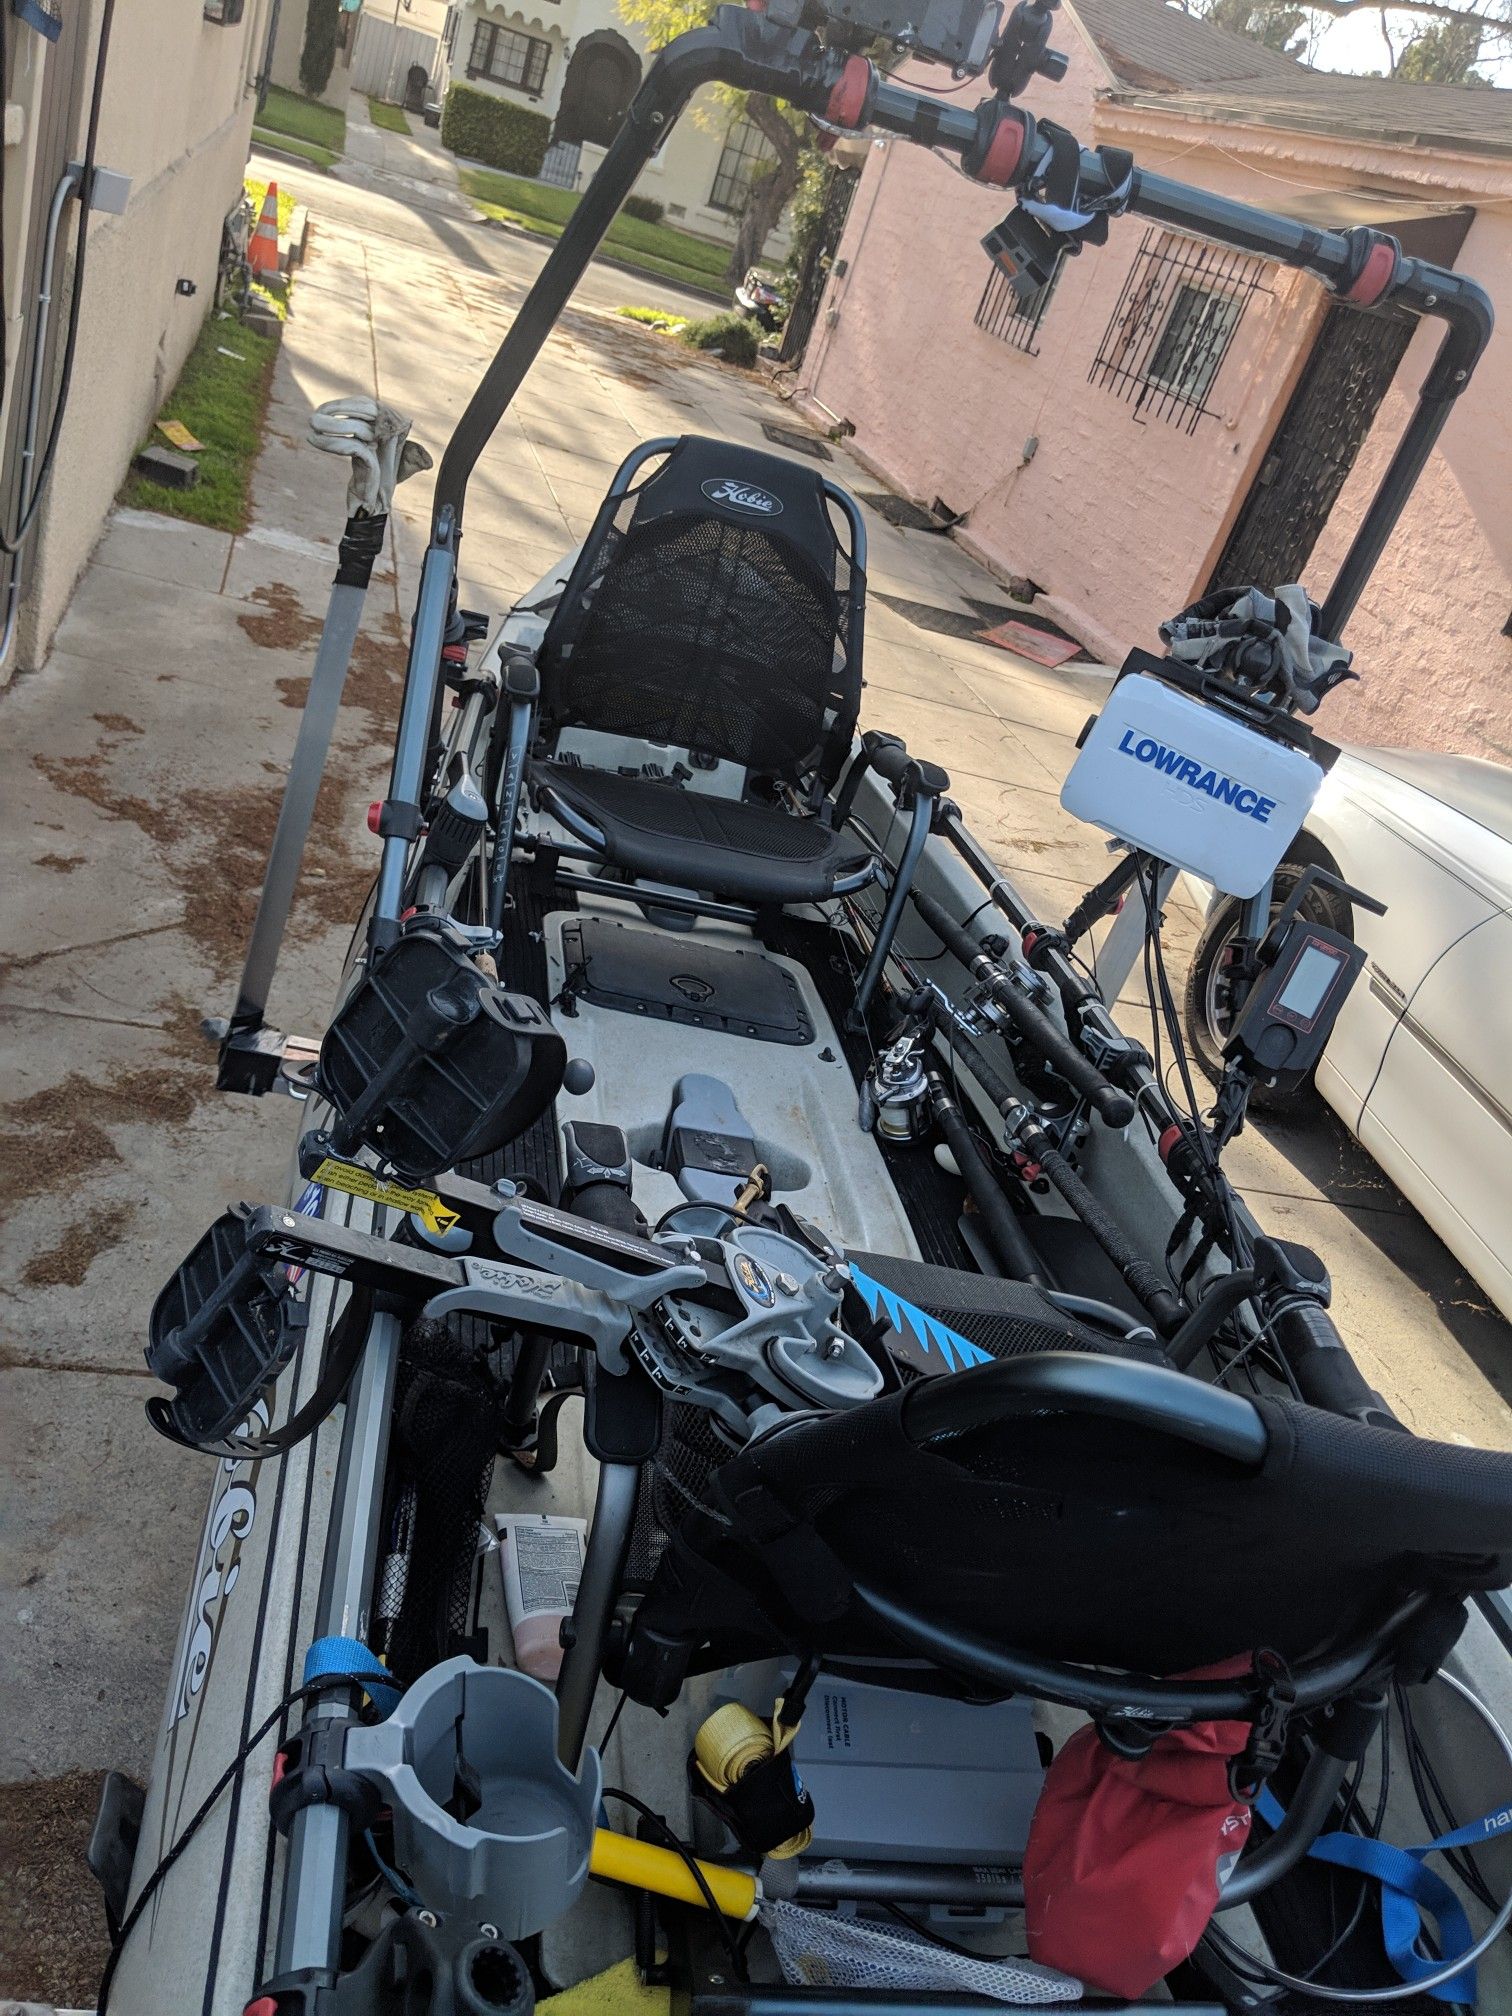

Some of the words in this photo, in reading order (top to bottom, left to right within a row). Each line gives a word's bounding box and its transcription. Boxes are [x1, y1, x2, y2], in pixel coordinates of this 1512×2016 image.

[711, 482, 773, 512] Hobie
[1118, 729, 1277, 824] LOWRANCE
[842, 1724, 851, 1747] CABLE
